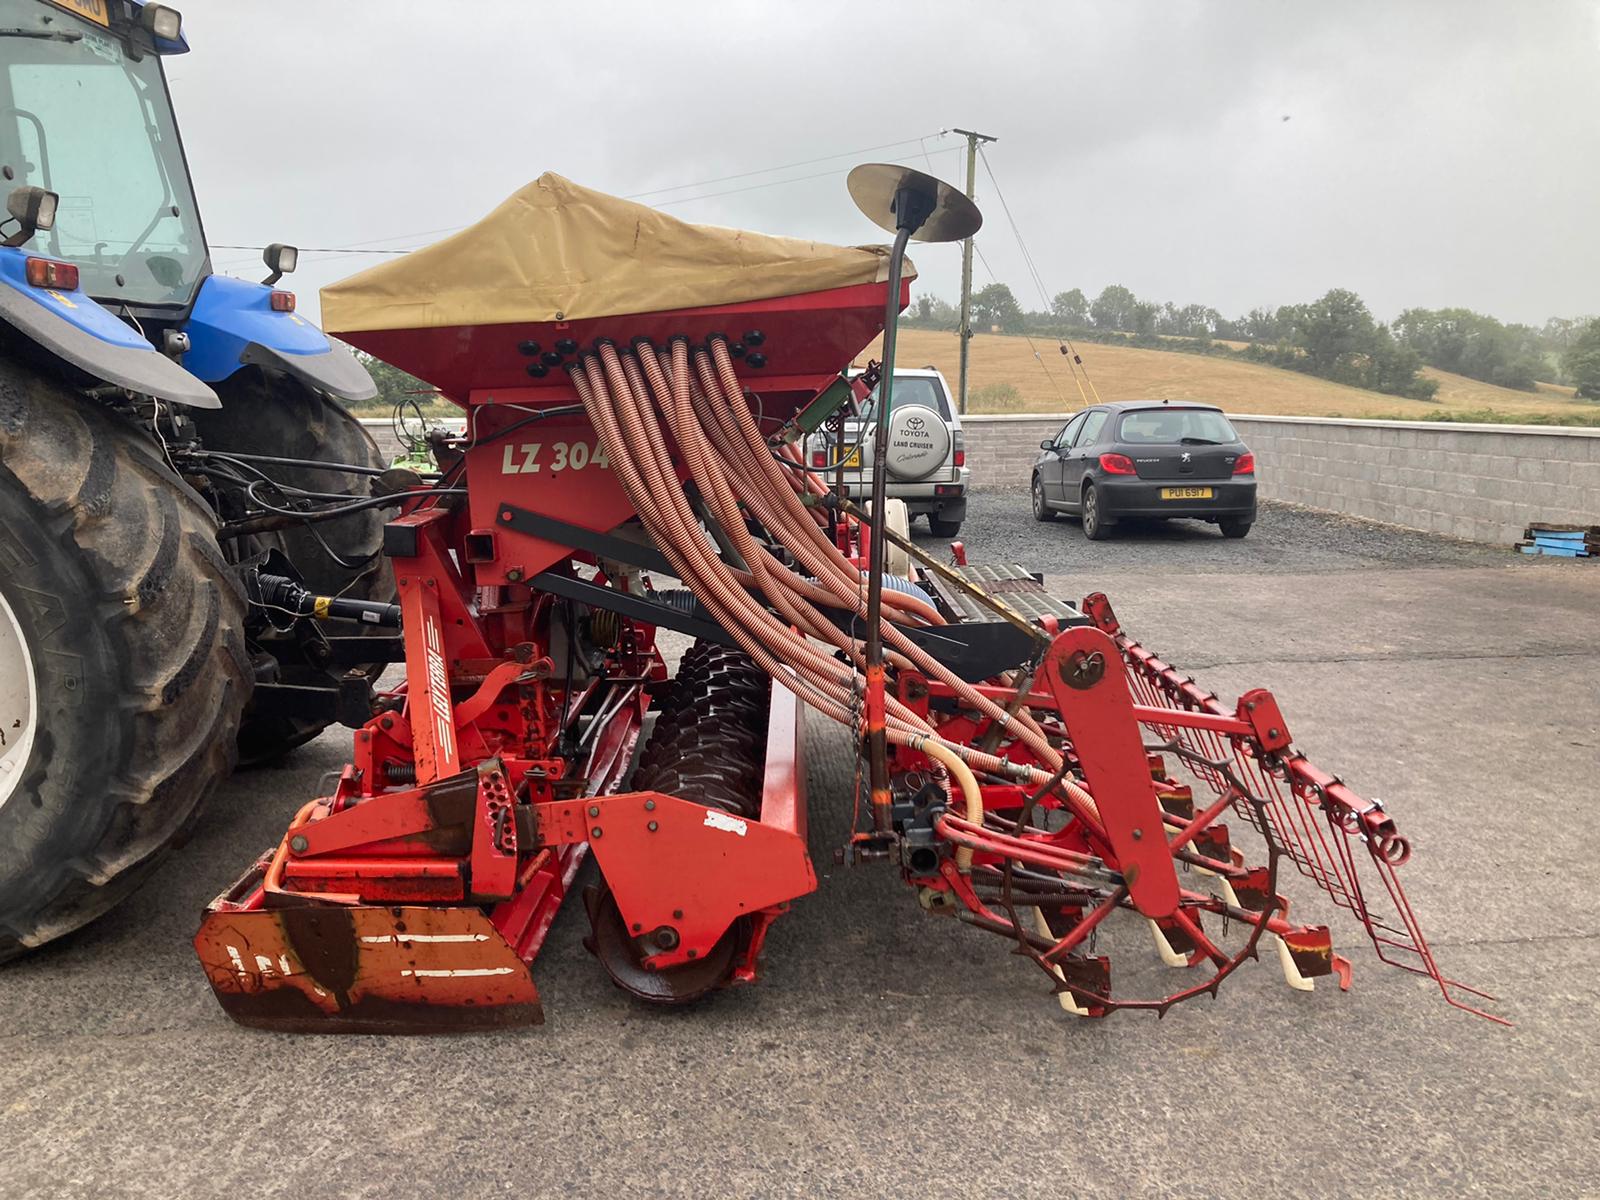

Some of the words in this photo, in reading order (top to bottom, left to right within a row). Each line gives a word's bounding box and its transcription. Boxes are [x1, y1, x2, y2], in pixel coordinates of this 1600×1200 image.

[900, 430, 930, 438] TOYOTA
[502, 443, 542, 475] LZ
[550, 441, 610, 471] 304
[1186, 488, 1205, 497] 6917
